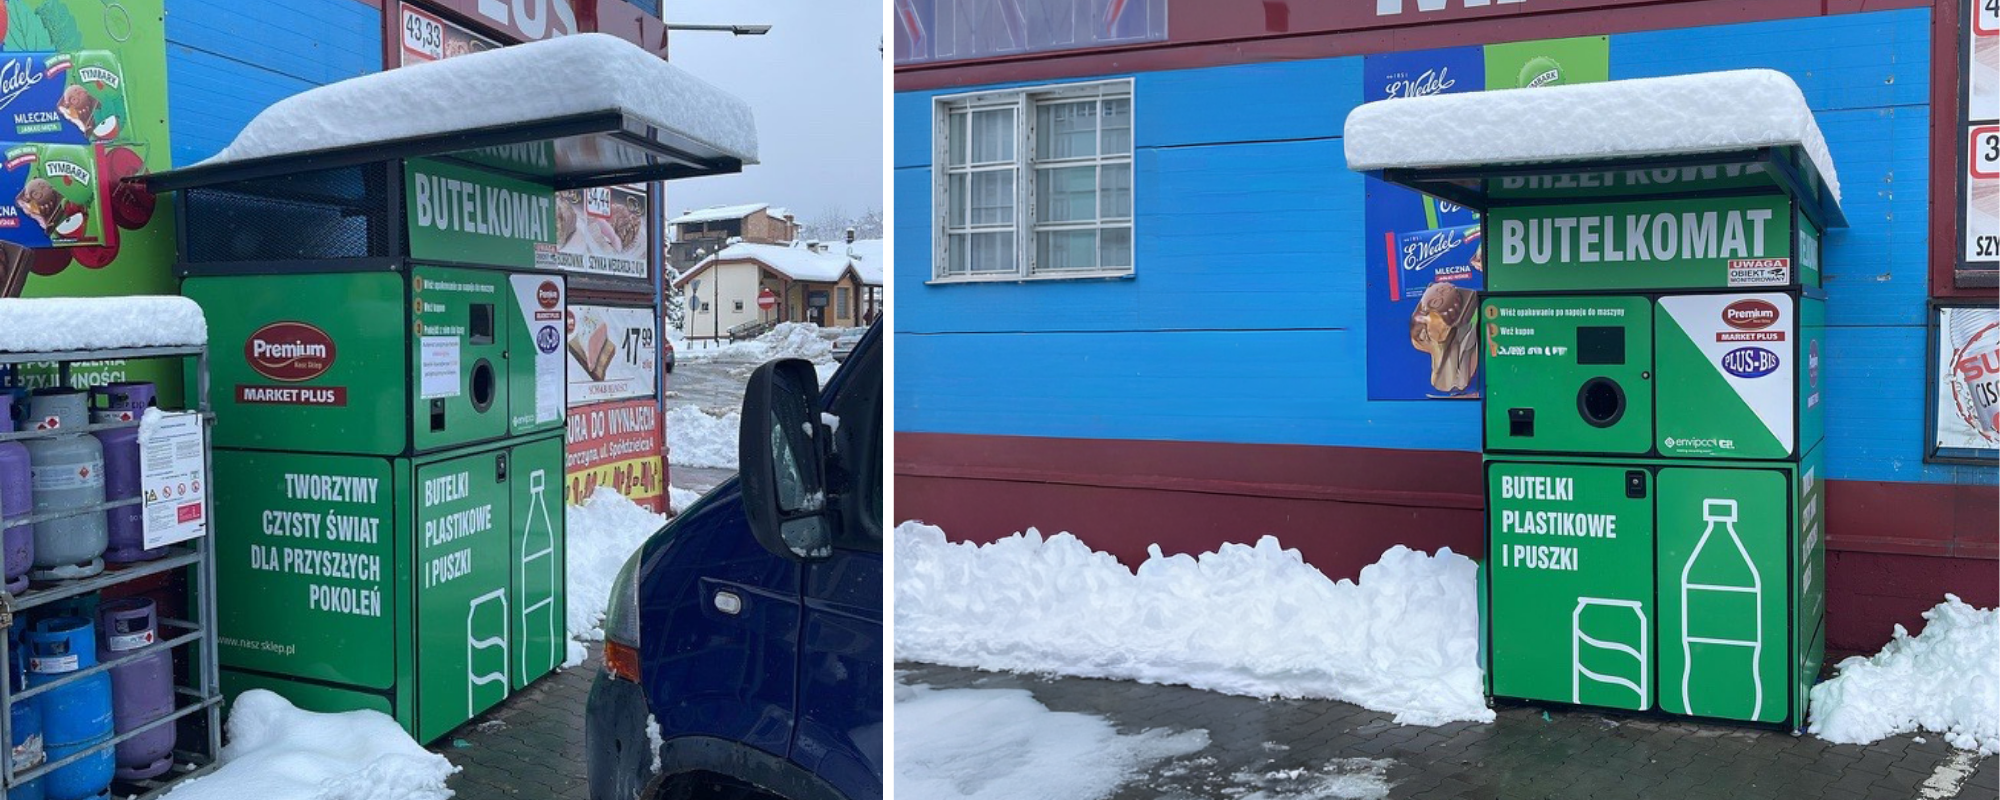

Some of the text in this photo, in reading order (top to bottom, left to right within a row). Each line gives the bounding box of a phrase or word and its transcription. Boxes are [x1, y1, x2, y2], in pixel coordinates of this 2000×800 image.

[406, 14, 441, 49] 43,33
[0, 57, 43, 93] edel
[81, 69, 117, 87] TYMBARK
[14, 112, 60, 124] MLECZNA
[47, 162, 88, 181] TYMBARK
[414, 173, 549, 242] BUTELKOMAT
[1502, 209, 1772, 264] BUTELKOMAT
[1435, 266, 1471, 275] MLECZNA
[1588, 307, 1596, 316] do
[1728, 303, 1774, 319] Premium
[253, 339, 326, 358] Premium
[622, 328, 653, 365] 17 99
[1725, 350, 1776, 372] PLUS-BIS
[244, 388, 335, 403] MARKET PLUS
[591, 411, 605, 439] DO
[608, 406, 655, 435] WYNAJĘCIA
[285, 473, 378, 503] TWORZYMY
[425, 471, 469, 507] BUTELKI
[1502, 476, 1573, 500] BUTELKI
[262, 509, 379, 543] CZYSTY ŚWIAT
[425, 505, 492, 548] PLASTIKOWE
[1502, 510, 1617, 538] PLASTIKOWE
[251, 544, 380, 581] DLA PRZYSZŁYCH
[425, 548, 471, 589] I PUSZKI
[1502, 544, 1578, 571] I PUSZKI
[309, 586, 381, 617] POKOLEŃ
